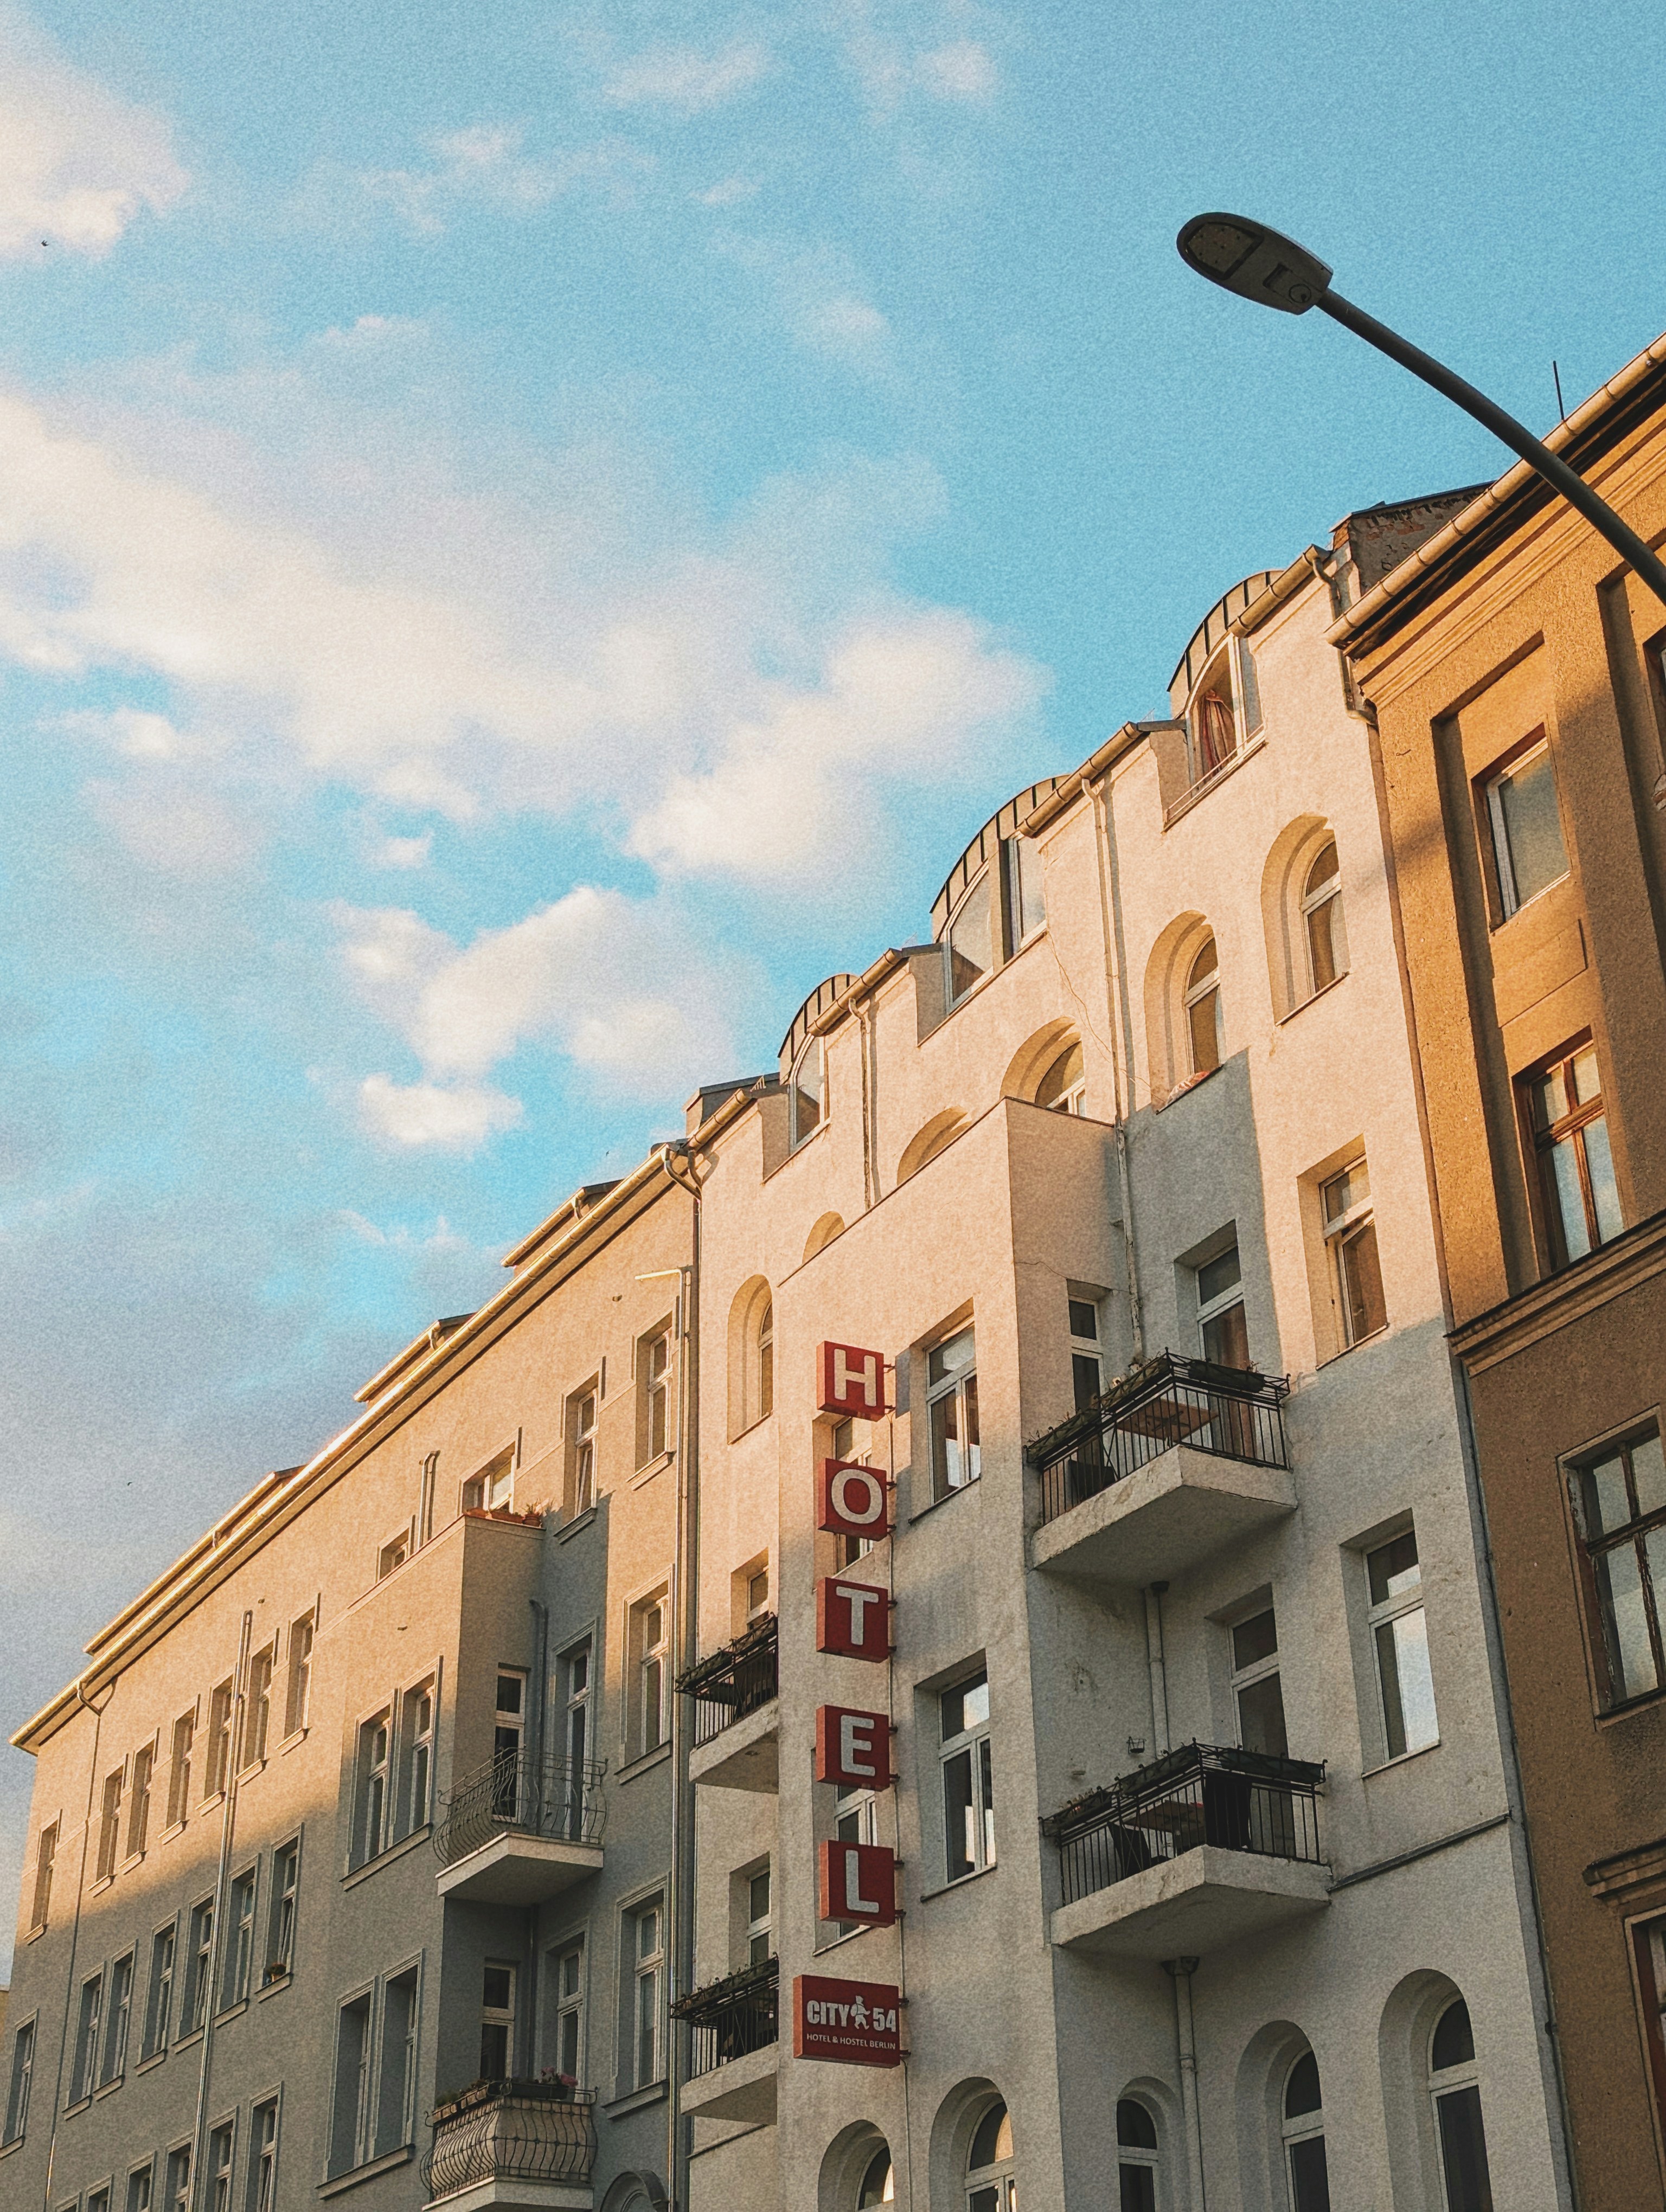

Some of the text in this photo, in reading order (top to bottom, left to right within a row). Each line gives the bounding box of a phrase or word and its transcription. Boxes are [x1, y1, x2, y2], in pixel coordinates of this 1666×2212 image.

[831, 1348, 883, 1914] HOTEL
[806, 2000, 896, 2033] CITY 54
[806, 2033, 831, 2043] HOTEL
[840, 2037, 868, 2047] HOSTEL
[869, 2040, 896, 2050] BERLIN
